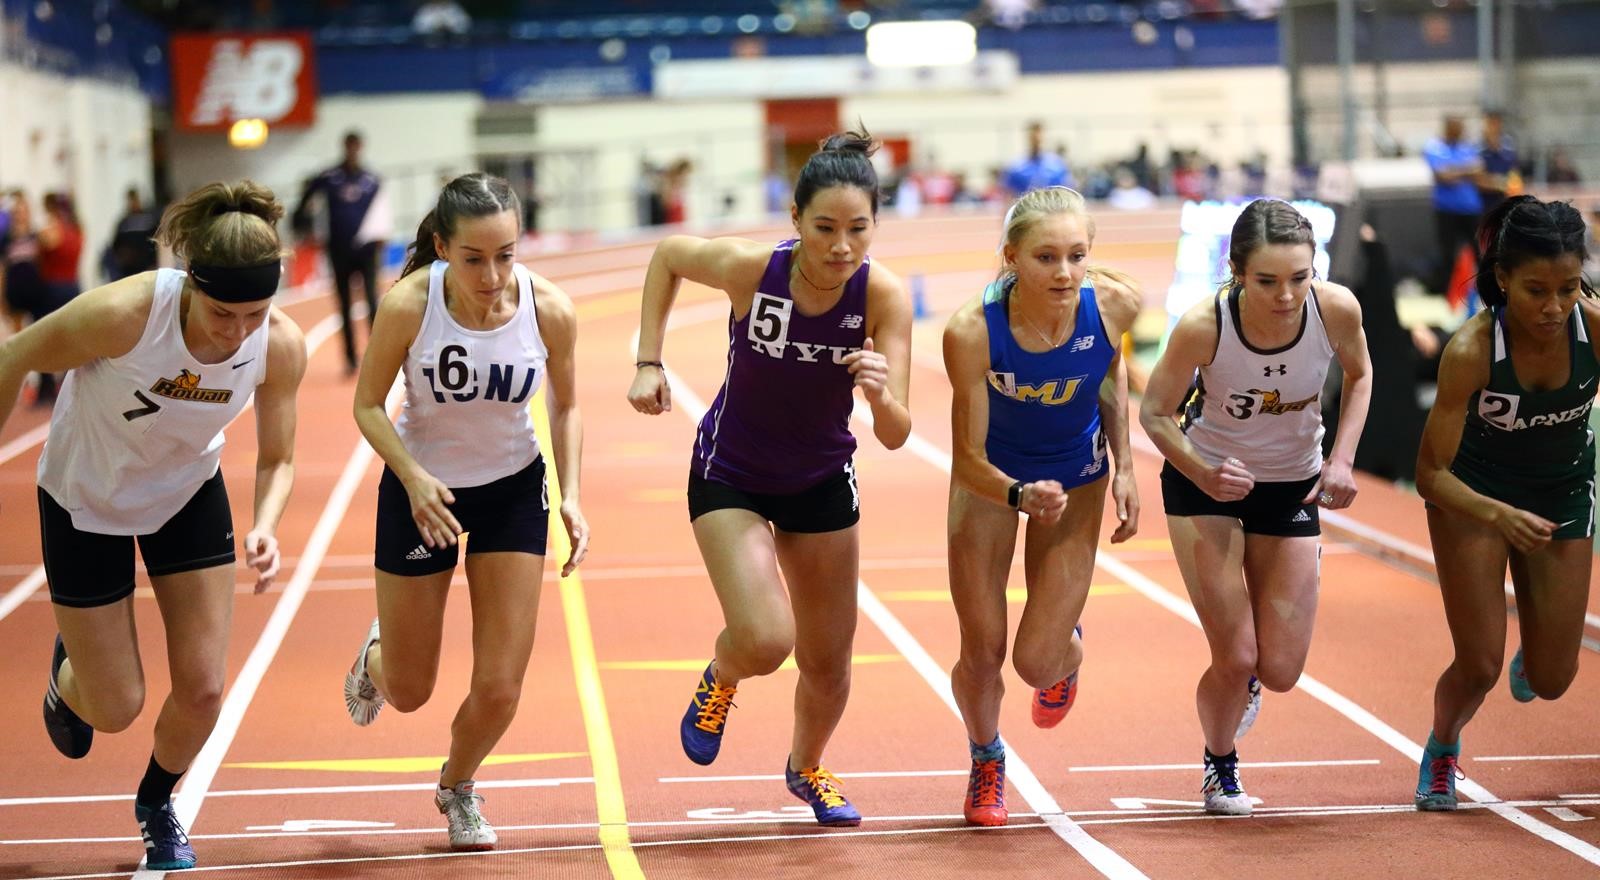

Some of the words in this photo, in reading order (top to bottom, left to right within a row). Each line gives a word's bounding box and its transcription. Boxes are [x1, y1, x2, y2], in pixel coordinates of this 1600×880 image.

[753, 297, 784, 342] 5
[438, 344, 469, 391] 6
[122, 390, 161, 422] 7
[1225, 393, 1255, 420] 3
[1483, 395, 1511, 428] 2
[1512, 395, 1595, 430] AGNER
